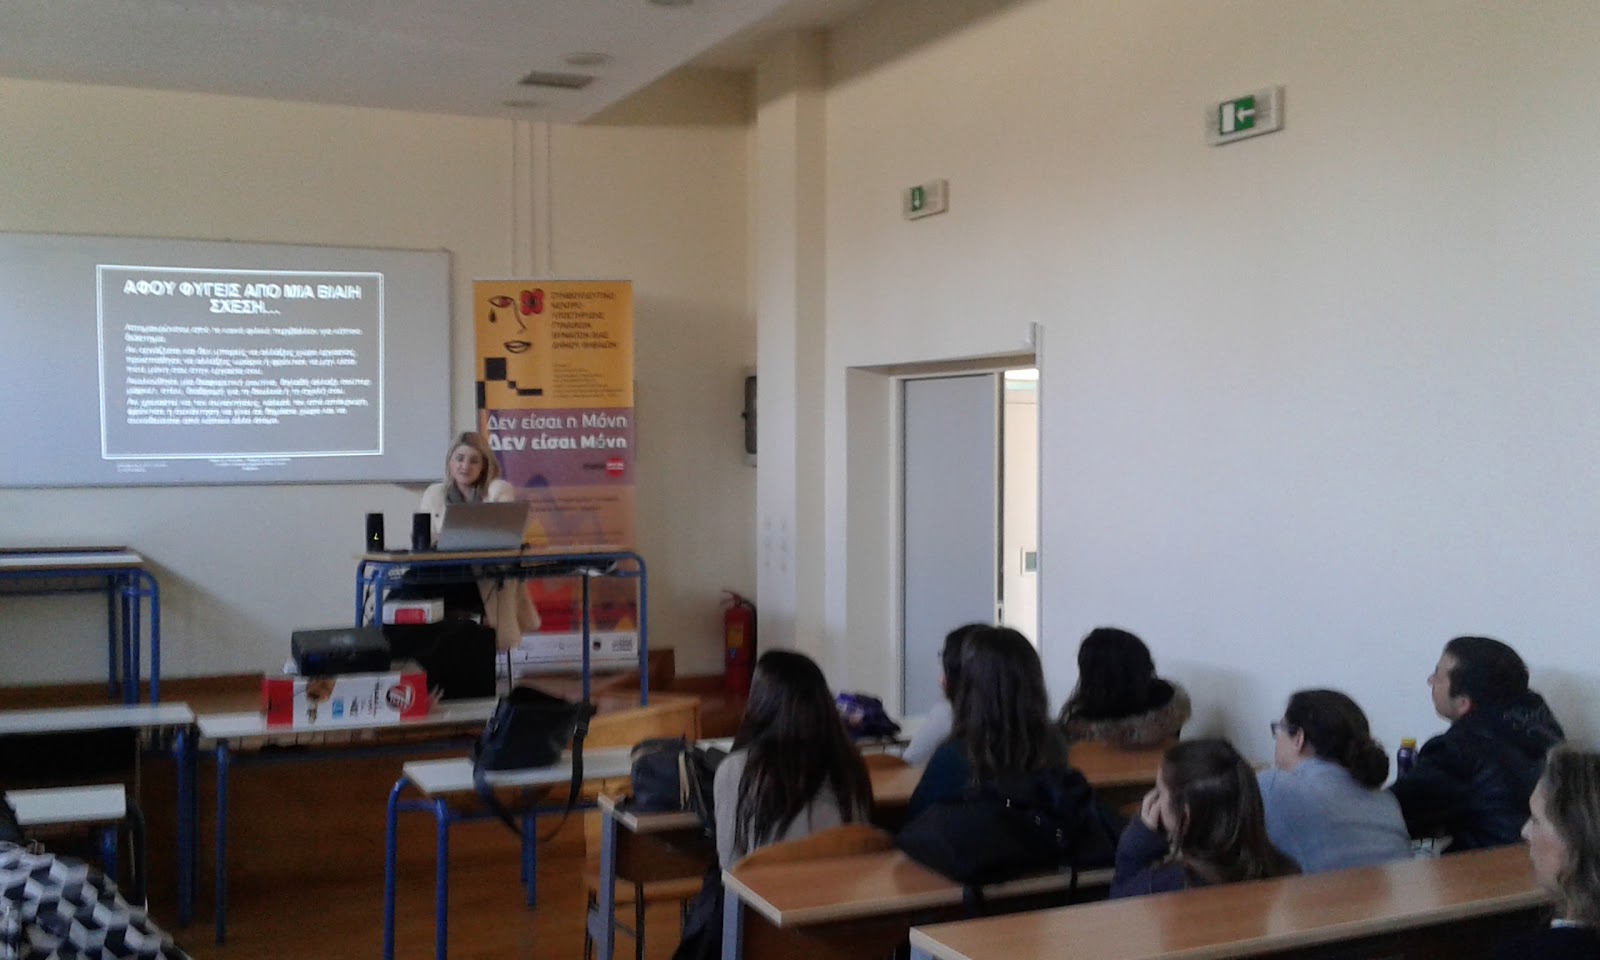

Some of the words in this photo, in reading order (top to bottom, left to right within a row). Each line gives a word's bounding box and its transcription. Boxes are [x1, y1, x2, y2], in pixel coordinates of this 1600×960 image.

[123, 280, 175, 297] ΑΦΟΥ
[179, 281, 242, 298] ΦΥΓΕΙΣ
[244, 283, 282, 299] ΑΠΟ
[283, 284, 315, 299] ΜΙΑ
[317, 285, 362, 300] ΒΙΑΙΗ
[487, 414, 518, 430] Δεν
[521, 413, 564, 430] είσαι
[566, 417, 578, 429] η
[581, 411, 628, 430] Μόνη
[488, 433, 527, 451] Δεν
[531, 432, 579, 450] είσαι
[580, 432, 628, 449] Μόνη
